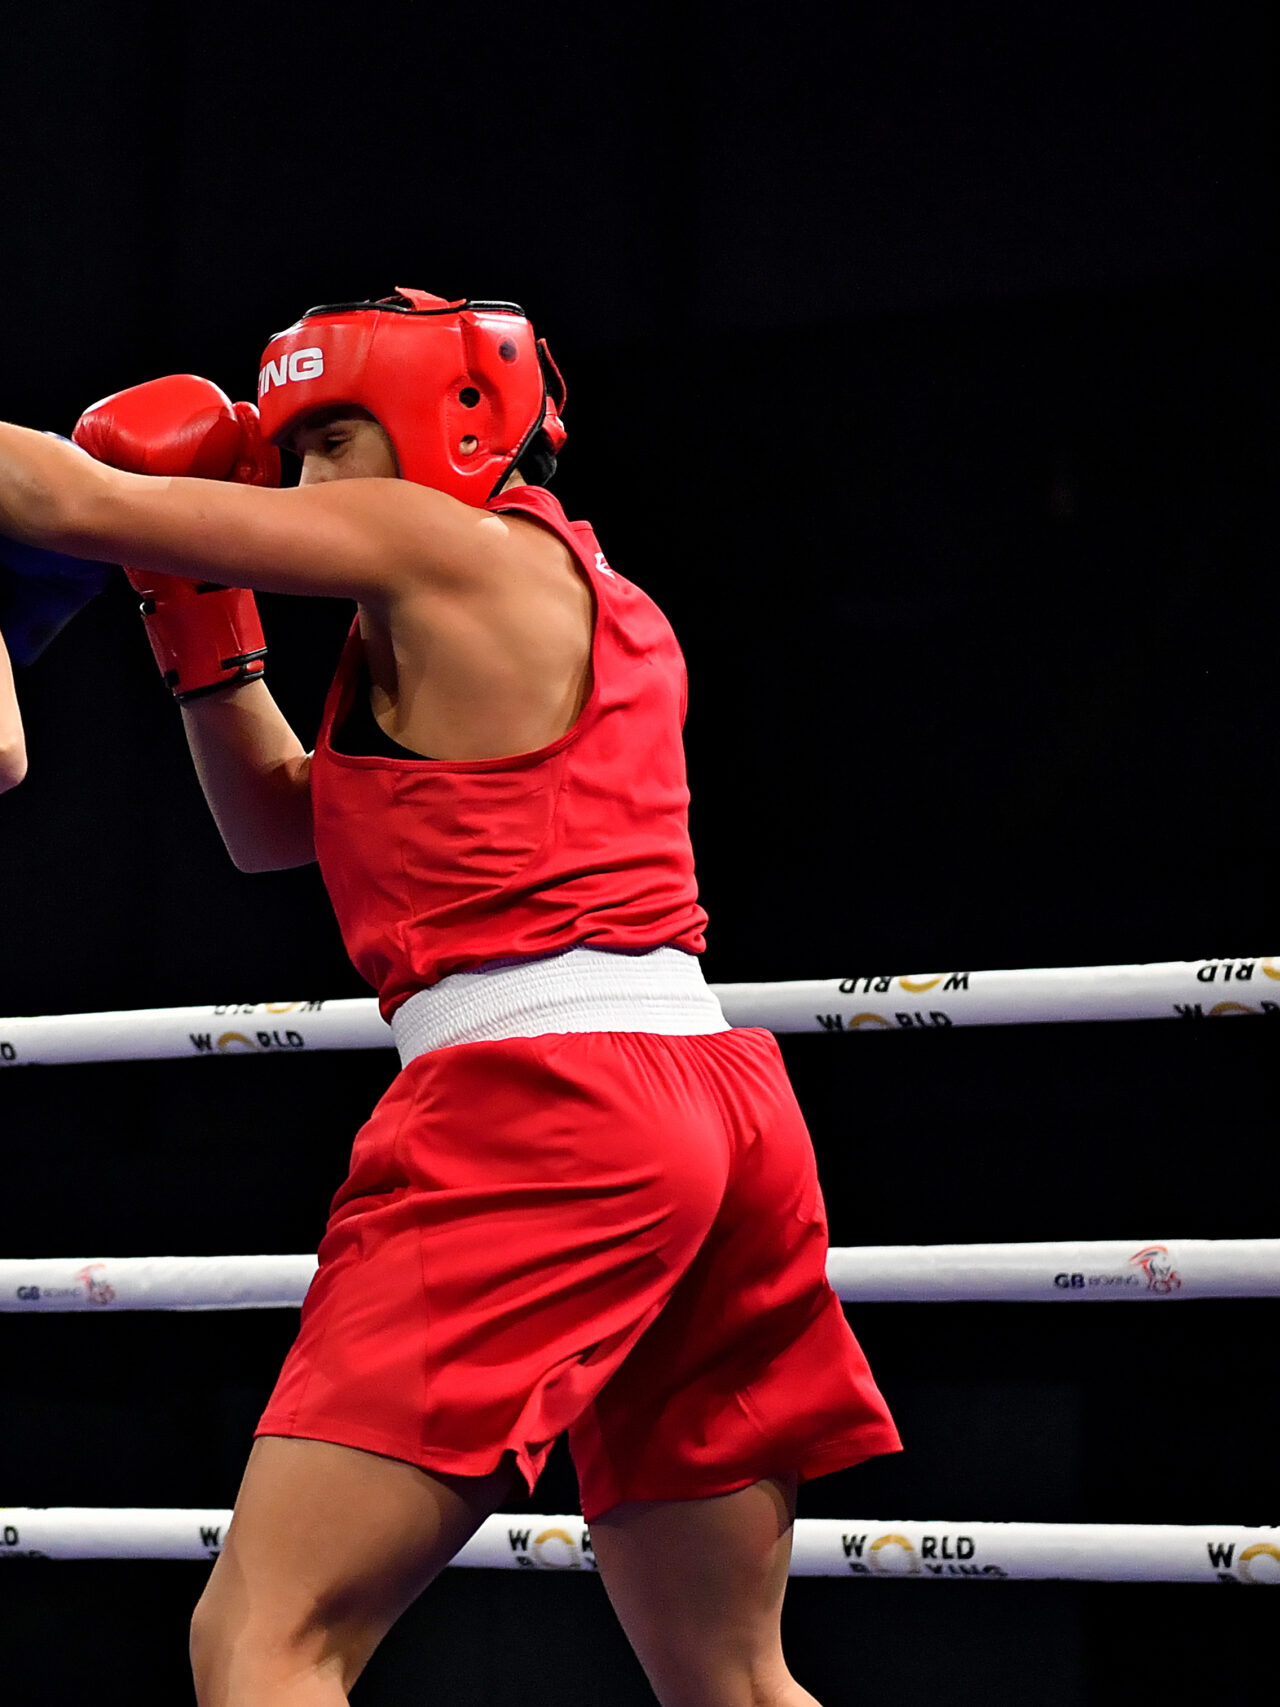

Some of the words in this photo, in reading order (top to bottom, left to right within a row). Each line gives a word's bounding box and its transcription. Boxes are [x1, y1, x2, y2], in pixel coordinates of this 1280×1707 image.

[258, 347, 324, 398] ING
[1054, 1272, 1086, 1289] GB
[842, 1533, 976, 1567] WORLD
